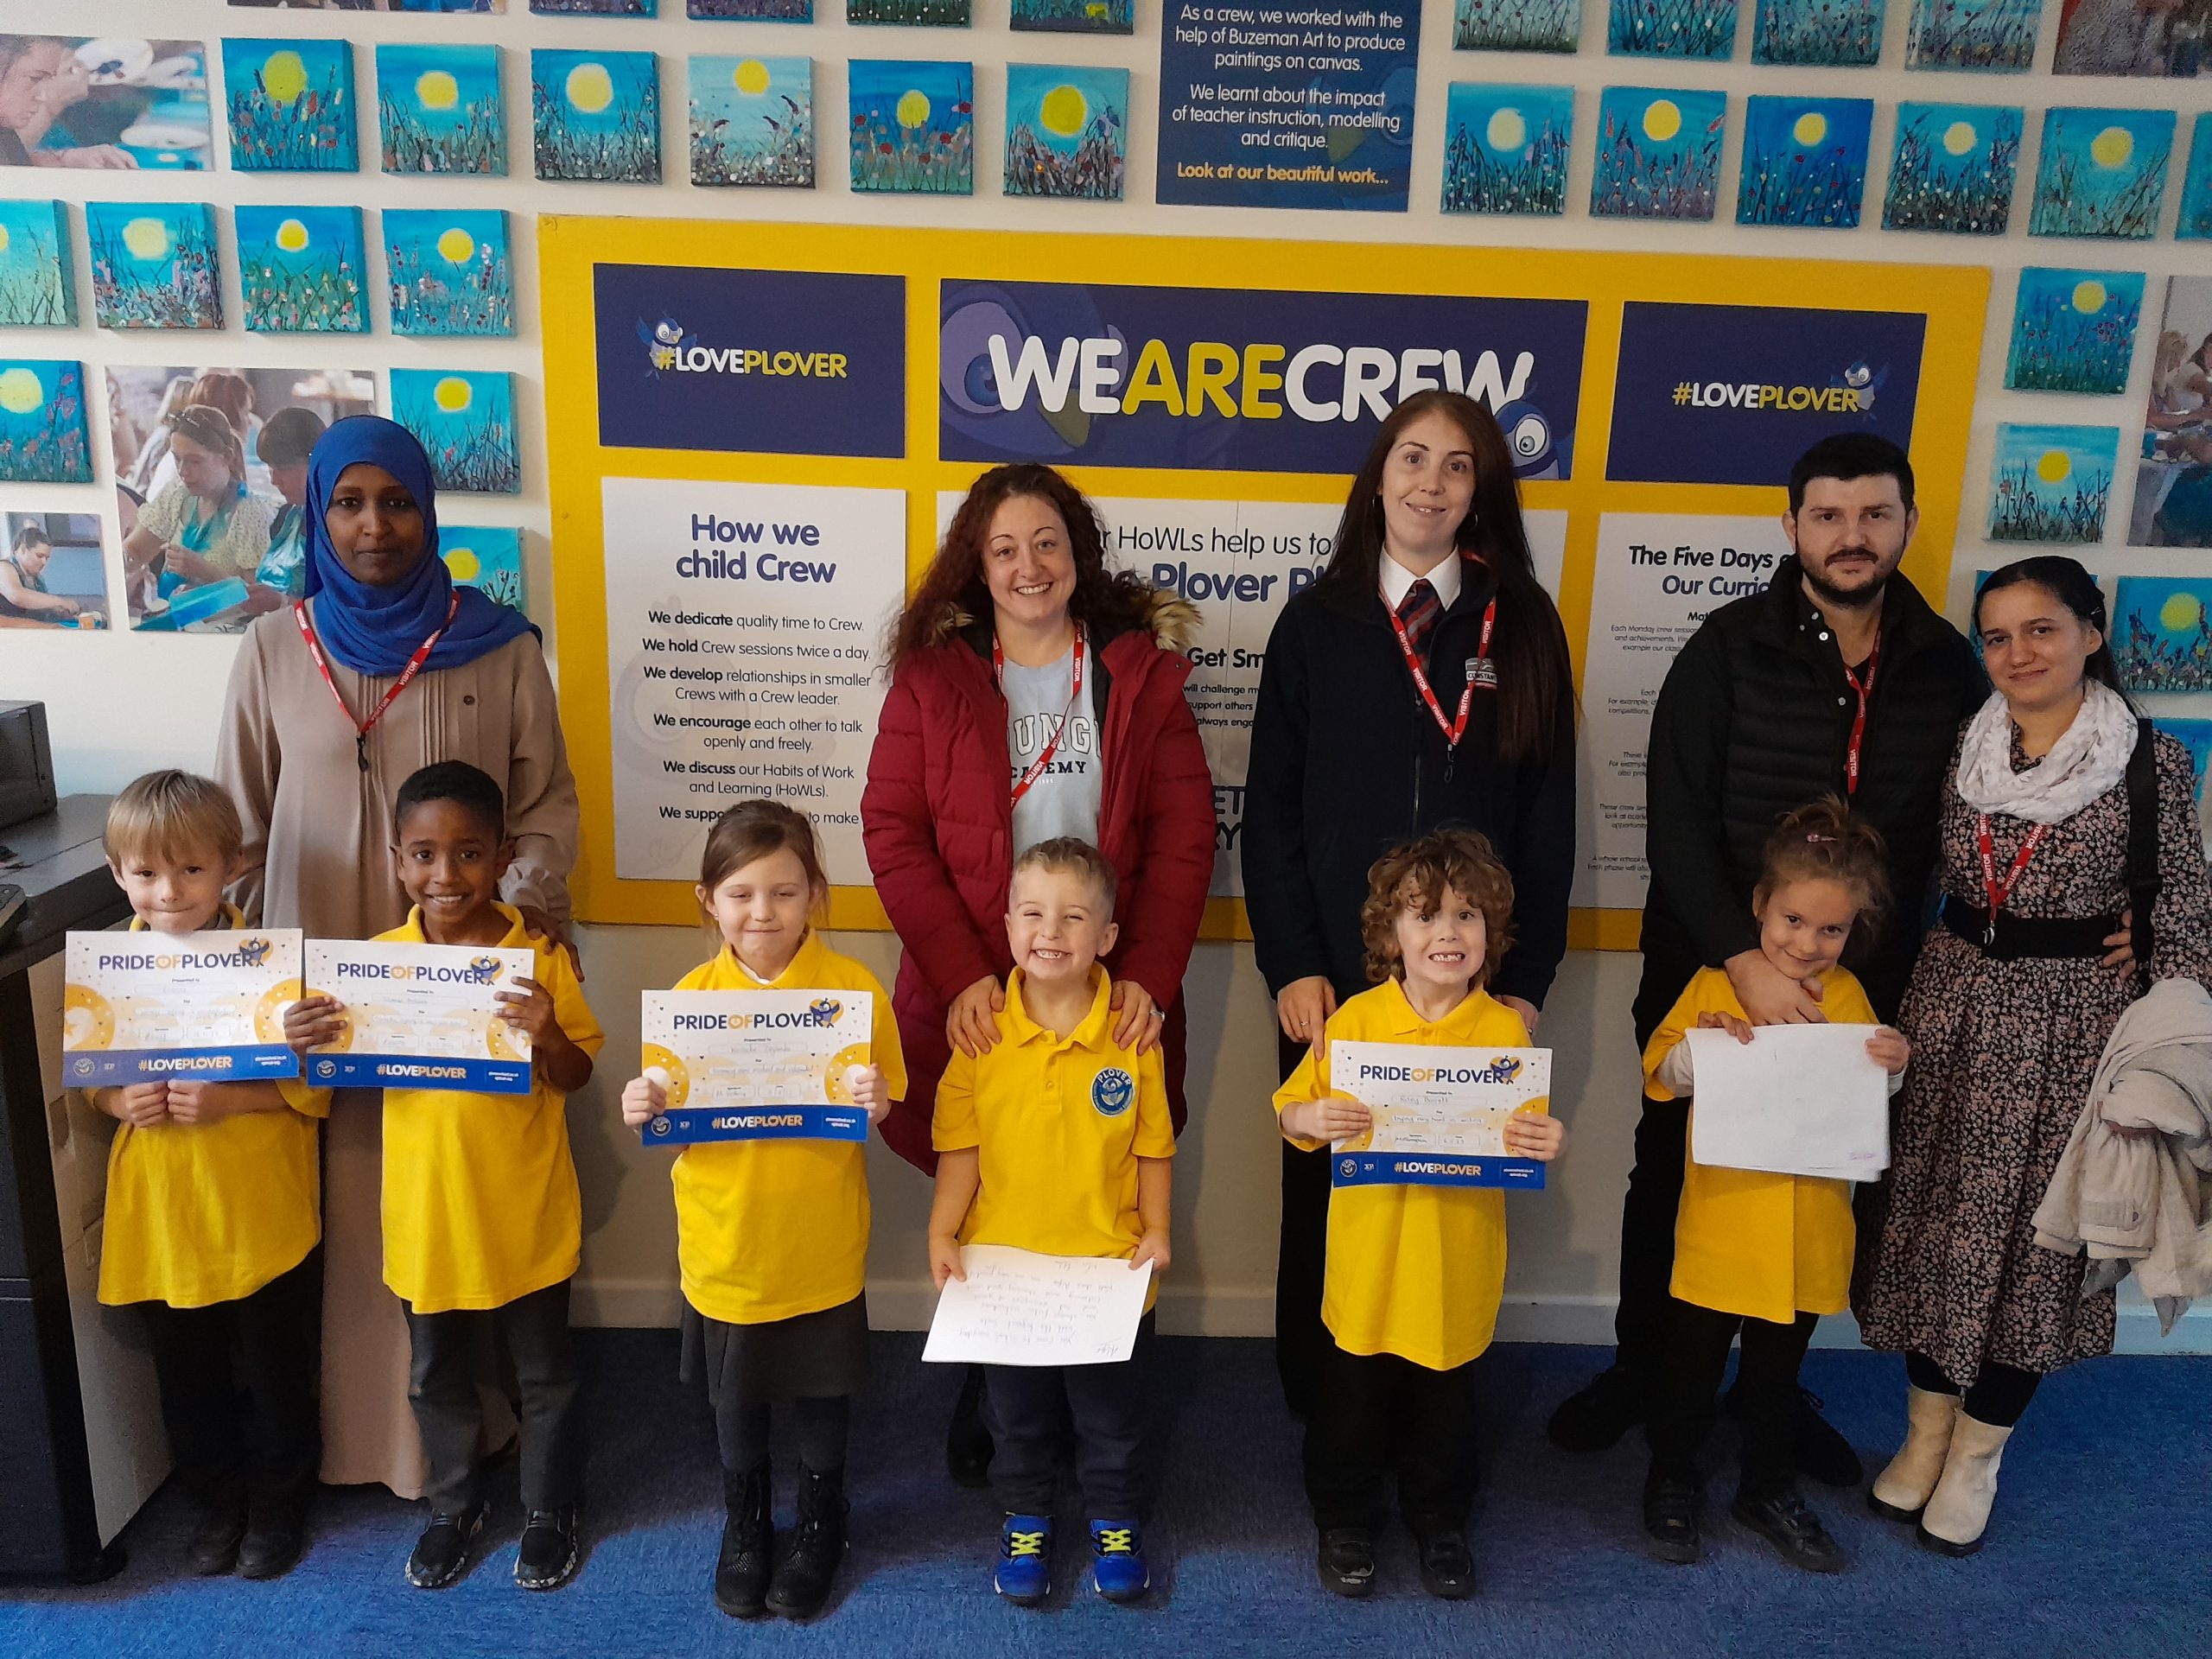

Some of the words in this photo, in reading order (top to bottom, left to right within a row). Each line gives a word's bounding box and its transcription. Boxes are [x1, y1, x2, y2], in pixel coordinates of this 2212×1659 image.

[1180, 4, 1199, 21] As
[1204, 10, 1214, 21] a
[1217, 10, 1255, 24] crew,
[1259, 12, 1282, 24] we
[1286, 10, 1340, 26] worked
[1344, 11, 1375, 28] with
[1379, 11, 1402, 29] the
[1175, 25, 1207, 46] help
[1211, 27, 1227, 43] of
[1229, 30, 1298, 47] Buzeman
[1302, 31, 1324, 48] Art
[1327, 34, 1341, 48] to
[1344, 33, 1405, 52] produce
[1215, 52, 1281, 72] paintings
[1285, 56, 1304, 70] on
[1308, 57, 1363, 72] canvas.
[1191, 84, 1214, 100] We
[1217, 85, 1259, 102] learnt
[1262, 86, 1305, 104] about
[1309, 88, 1332, 105] the
[1335, 90, 1385, 109] impact
[1173, 105, 1187, 121] of
[1190, 106, 1243, 124] teacher
[1248, 108, 1325, 128] instruction,
[1328, 111, 1401, 133] modelling
[1241, 130, 1269, 146] and
[1274, 131, 1328, 150] critique.
[1177, 162, 1213, 178] Look
[1217, 163, 1234, 179] at
[1236, 167, 1263, 180] our
[1267, 163, 1334, 182] beautiful
[1338, 167, 1389, 185] work...
[657, 346, 848, 378] #LOVEPLOVER
[1672, 382, 1859, 413] #LOVEPLOVER
[691, 514, 764, 543] How
[772, 524, 820, 545] we
[1118, 525, 1204, 552] HoWLs
[1211, 527, 1265, 560] help
[1273, 537, 1301, 555] us
[1308, 532, 1332, 556] to
[676, 549, 747, 580] child
[757, 554, 836, 583] Crew
[1629, 545, 1667, 566] The
[1673, 546, 1714, 567] Five
[1720, 548, 1773, 573] Days
[1152, 561, 1278, 602] Plover
[1662, 575, 1703, 595] Our
[648, 611, 671, 625] We
[675, 612, 734, 627] dedicate
[736, 614, 779, 631] quality
[781, 616, 810, 629] time
[813, 617, 825, 630] to
[829, 618, 864, 632] Crew.
[642, 639, 664, 652] We
[669, 639, 697, 652] hold
[702, 641, 736, 654] Crew
[739, 642, 793, 657] sessions
[797, 645, 830, 658] twice
[833, 648, 842, 658] a
[845, 645, 871, 662] day.
[1398, 630, 1412, 656] VISITOR
[1186, 647, 1227, 667] Get
[398, 661, 419, 686] VISITOR
[644, 666, 666, 679] We
[670, 667, 723, 683] develop
[727, 670, 807, 686] relationships
[810, 672, 822, 684] in
[824, 673, 871, 687] smaller
[1413, 667, 1428, 692] VISITOR
[675, 687, 715, 701] Crews
[719, 689, 745, 702] with
[748, 692, 758, 702] a
[761, 690, 794, 704] Crew
[798, 691, 840, 706] leader.
[1200, 684, 1245, 696] challenge
[1224, 701, 1253, 710] others
[1459, 689, 1471, 716] VISITOR
[653, 714, 676, 727] We
[679, 716, 751, 732] encourage
[754, 717, 785, 731] each
[789, 719, 822, 732] other
[825, 720, 837, 733] to
[841, 720, 863, 734] talk
[1196, 716, 1228, 728] always
[1432, 703, 1449, 730] VISITOR
[703, 736, 746, 751] openly
[749, 737, 774, 750] and
[778, 738, 813, 753] freely.
[663, 760, 685, 773] We
[689, 760, 735, 775] discuss
[739, 766, 760, 776] our
[763, 763, 804, 778] Habits
[806, 765, 820, 778] of
[823, 765, 855, 779] Work
[1023, 760, 1046, 785] VISITOR
[690, 781, 714, 793] and
[718, 782, 772, 798] Learning
[775, 784, 829, 798] (HoWLs).
[659, 805, 681, 819] We
[684, 809, 724, 823] suppo
[808, 811, 820, 823] to
[823, 811, 859, 825] make
[2025, 823, 2044, 849] VISITOR
[1983, 853, 1993, 882] VISITOR
[2005, 865, 2022, 890] VISITOR
[99, 953, 253, 970] PRIDEOFPLOVER
[337, 963, 485, 985] PRIDEOFPLOVER
[673, 1014, 824, 1030] PRIDEOFPLOVER
[138, 1056, 232, 1072] #LOVEPLOVER
[377, 1064, 467, 1079] #LOVEPLOVER
[1360, 1065, 1503, 1084] PRIDEOFPLOVER
[1096, 1068, 1132, 1085] PLOVER
[712, 1114, 803, 1129] #LOVEPLOVER
[1395, 1161, 1482, 1177] #LOVEPLOVER
